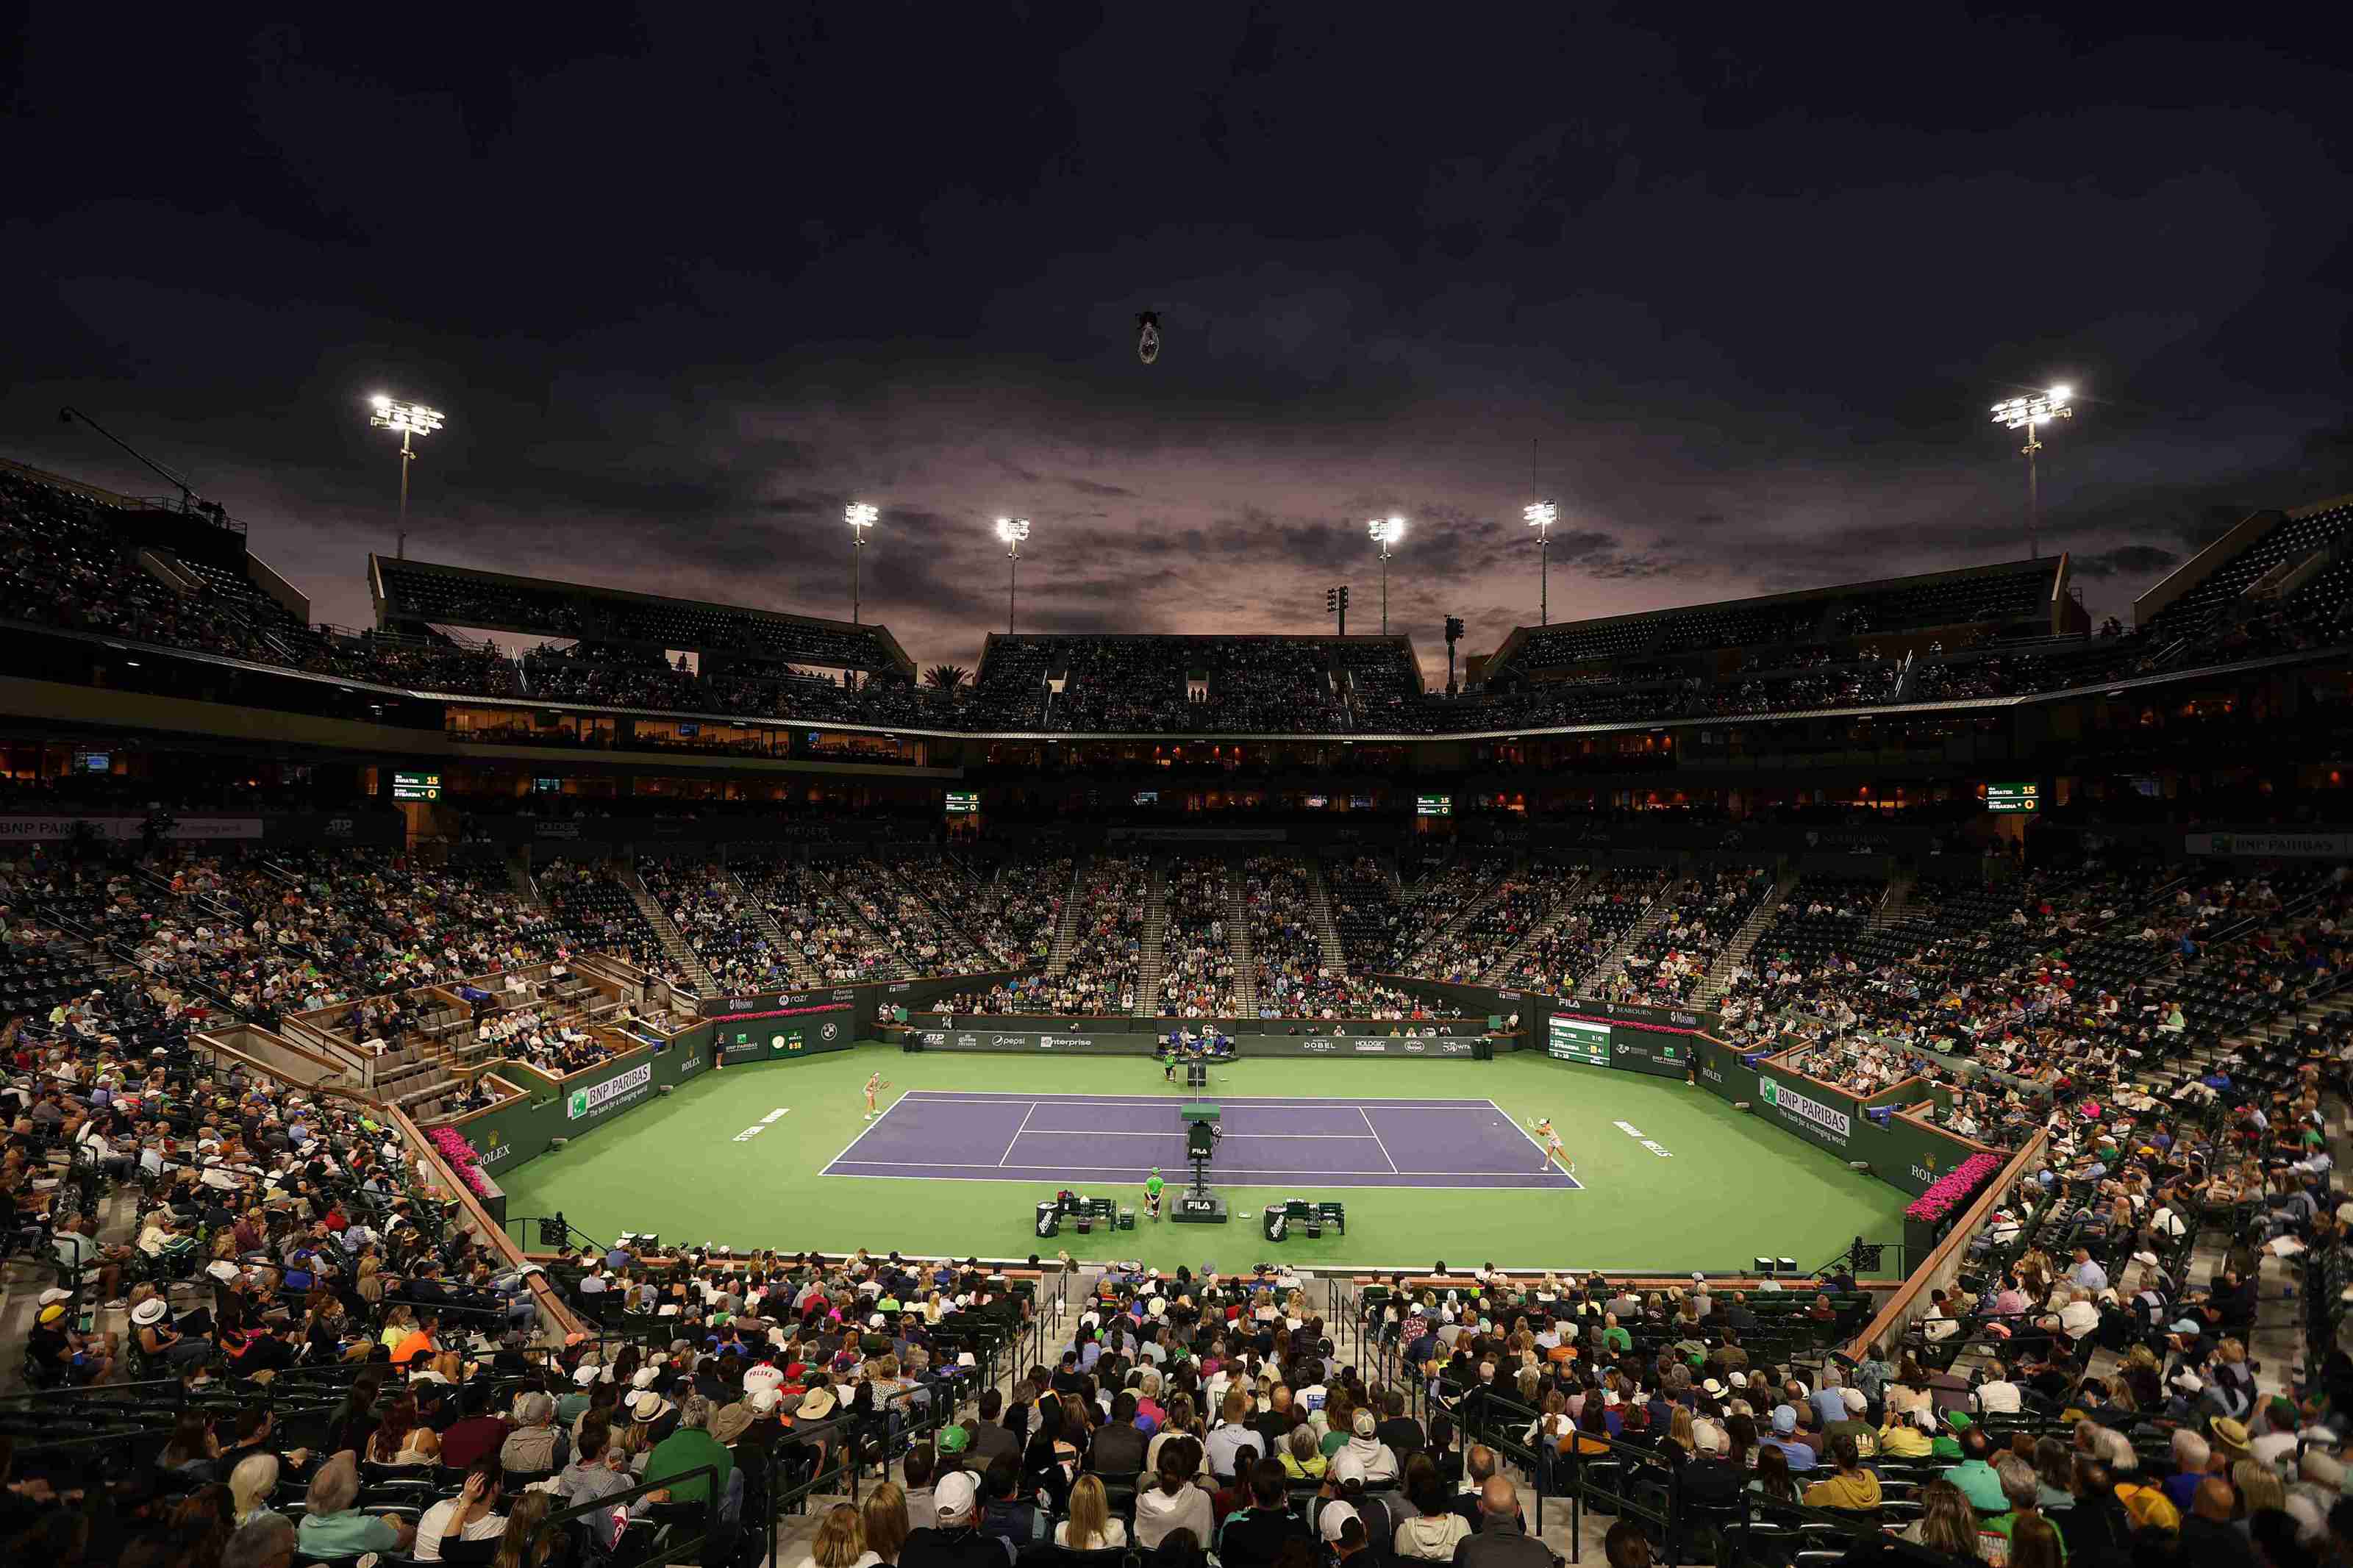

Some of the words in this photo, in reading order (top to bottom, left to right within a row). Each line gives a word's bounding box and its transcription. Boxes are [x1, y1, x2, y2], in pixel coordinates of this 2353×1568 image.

[426, 776, 438, 785] 15
[427, 789, 437, 799] 0
[2023, 786, 2036, 795] 15
[970, 803, 976, 812] 0
[2024, 800, 2035, 810] 0
[0, 823, 35, 834] BNP
[39, 822, 106, 835] PARAS
[1558, 998, 1581, 1009] FILA
[1003, 1037, 1025, 1046] pepsi
[682, 1056, 701, 1072] ROLEX
[1702, 1067, 1723, 1083] ROLEX
[589, 1084, 609, 1105] BNP
[612, 1066, 648, 1092] PARIBAS
[589, 1109, 599, 1118] The
[1779, 1088, 1799, 1109] BNP
[1802, 1099, 1846, 1131] PARIBAS
[1911, 1164, 1941, 1185] ROLE
[1188, 1201, 1210, 1210] FILA
